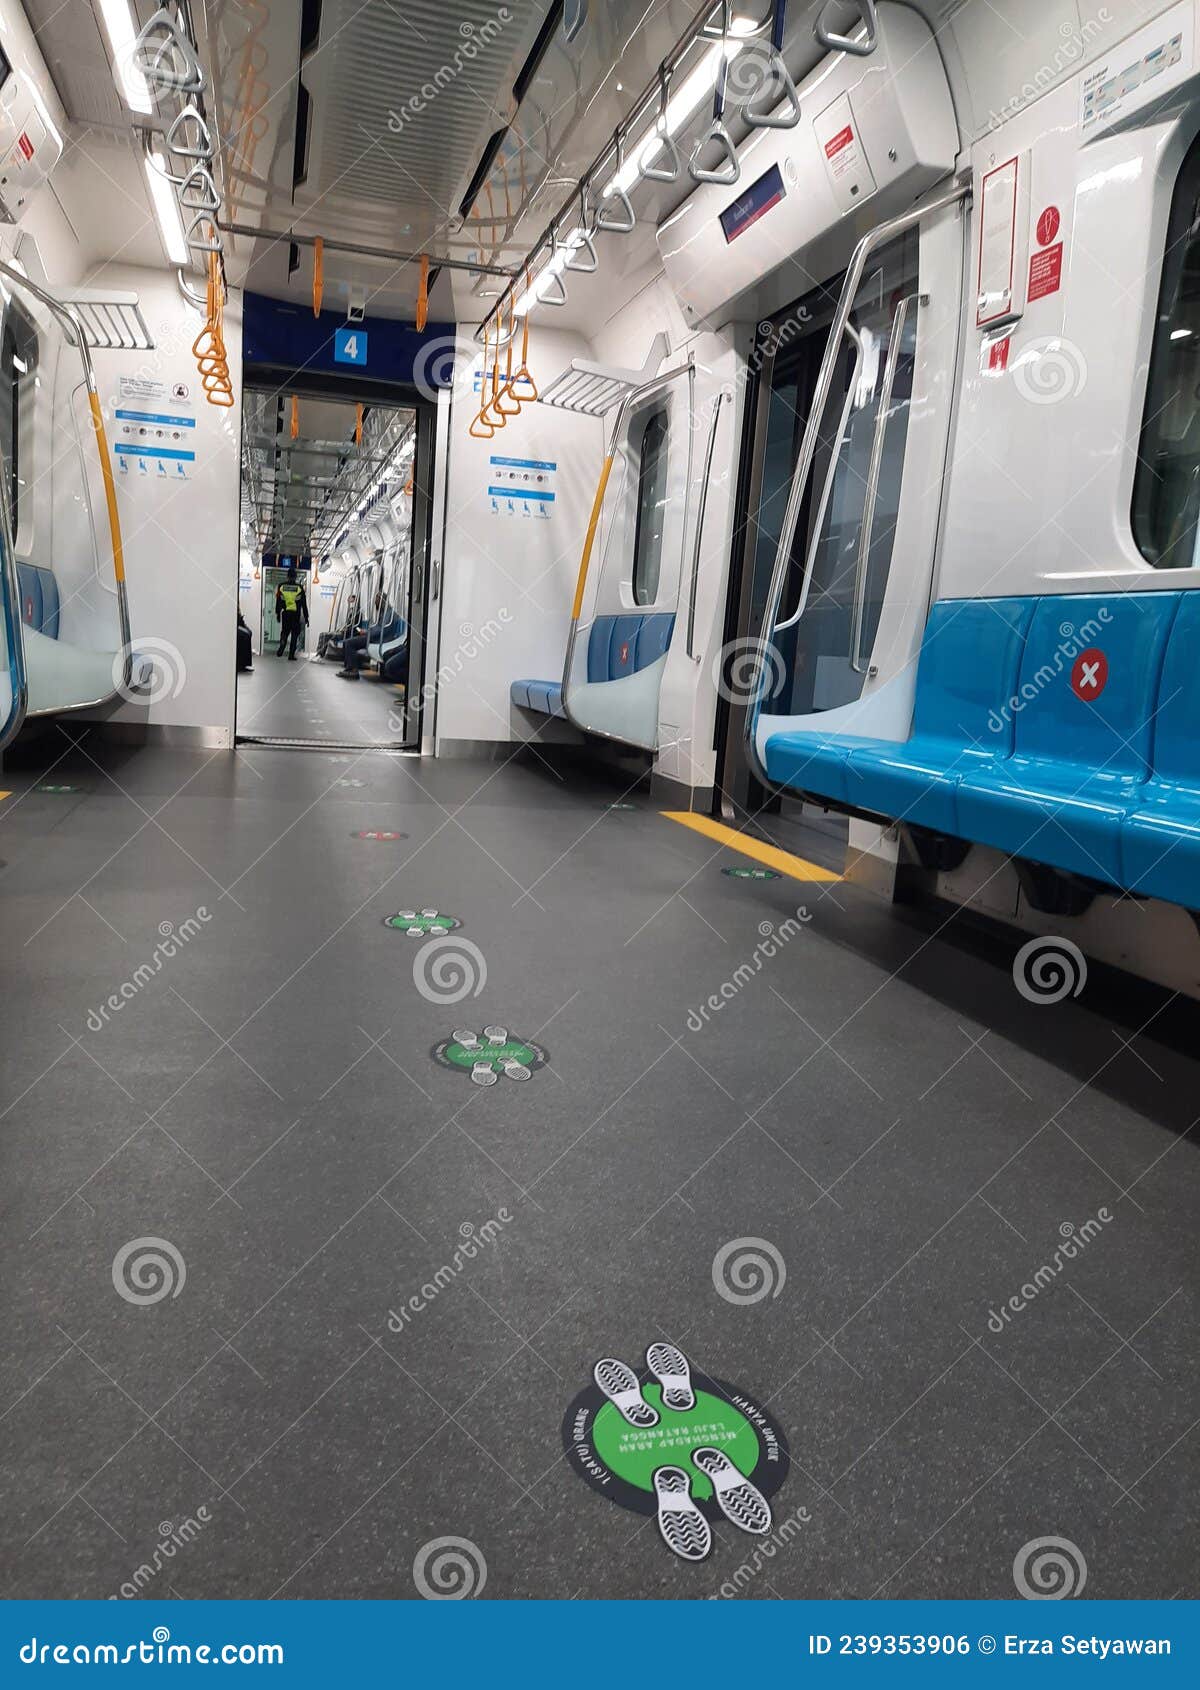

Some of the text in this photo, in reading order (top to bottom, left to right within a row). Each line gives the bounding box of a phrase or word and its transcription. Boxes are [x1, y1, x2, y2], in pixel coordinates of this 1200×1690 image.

[344, 335, 358, 359] 4
[572, 1407, 590, 1441] ORANG
[694, 1422, 726, 1433] LAJU
[731, 1395, 779, 1463] HANYA UNTUK
[619, 1431, 737, 1453] MENGHADAP ARAH
